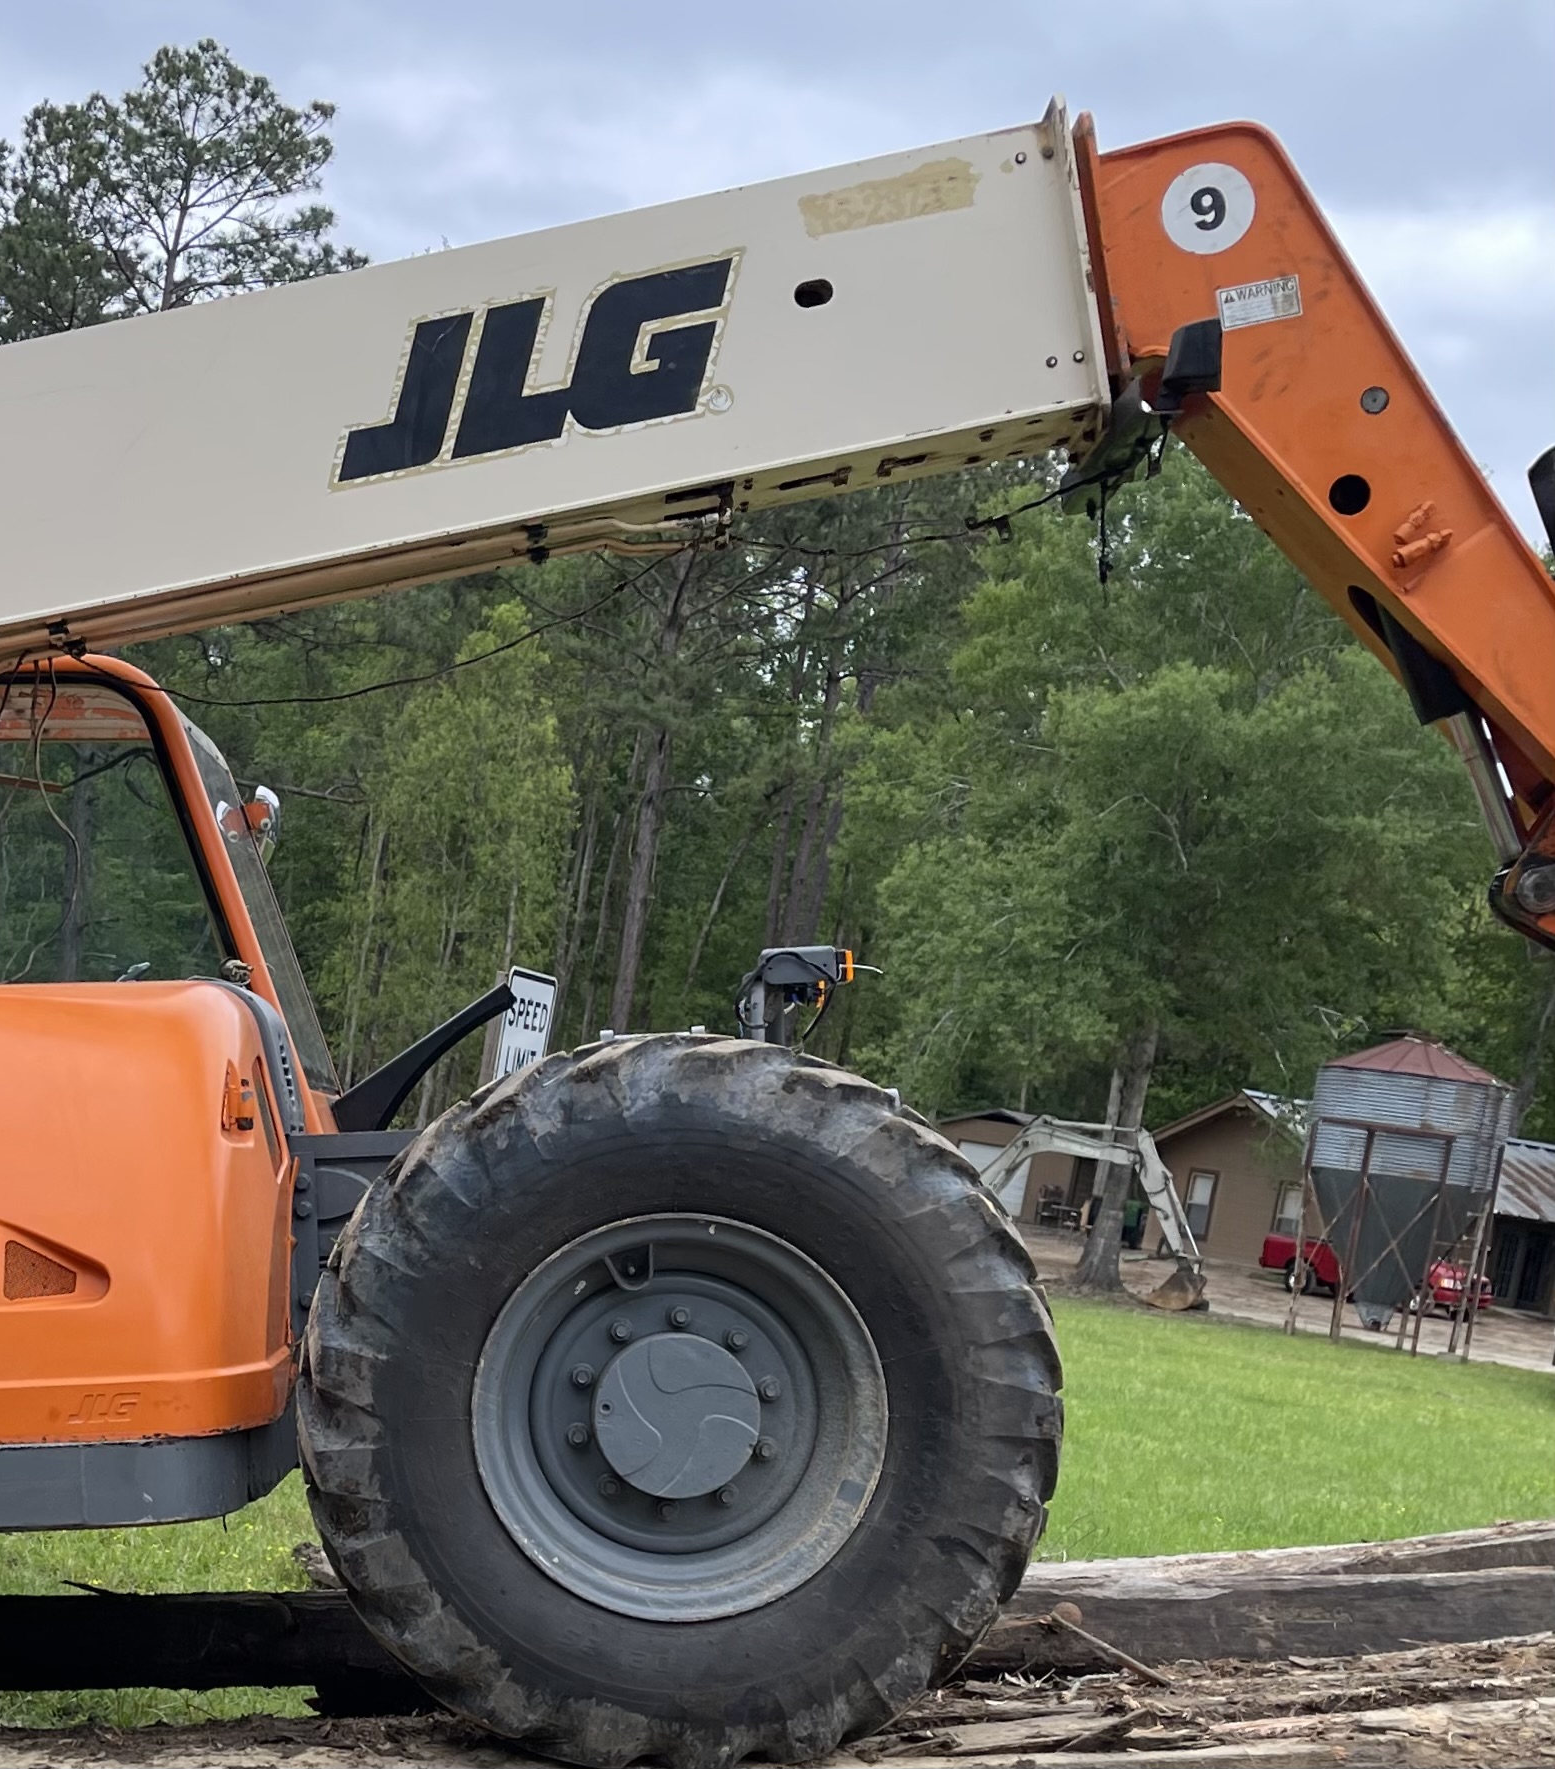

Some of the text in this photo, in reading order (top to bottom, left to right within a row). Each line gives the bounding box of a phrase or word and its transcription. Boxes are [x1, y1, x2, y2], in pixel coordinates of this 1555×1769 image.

[1190, 186, 1226, 231] 9
[1235, 279, 1295, 301] WARNING
[337, 256, 733, 483] JLG
[507, 997, 548, 1034] SPEED
[66, 1391, 142, 1424] JLG
